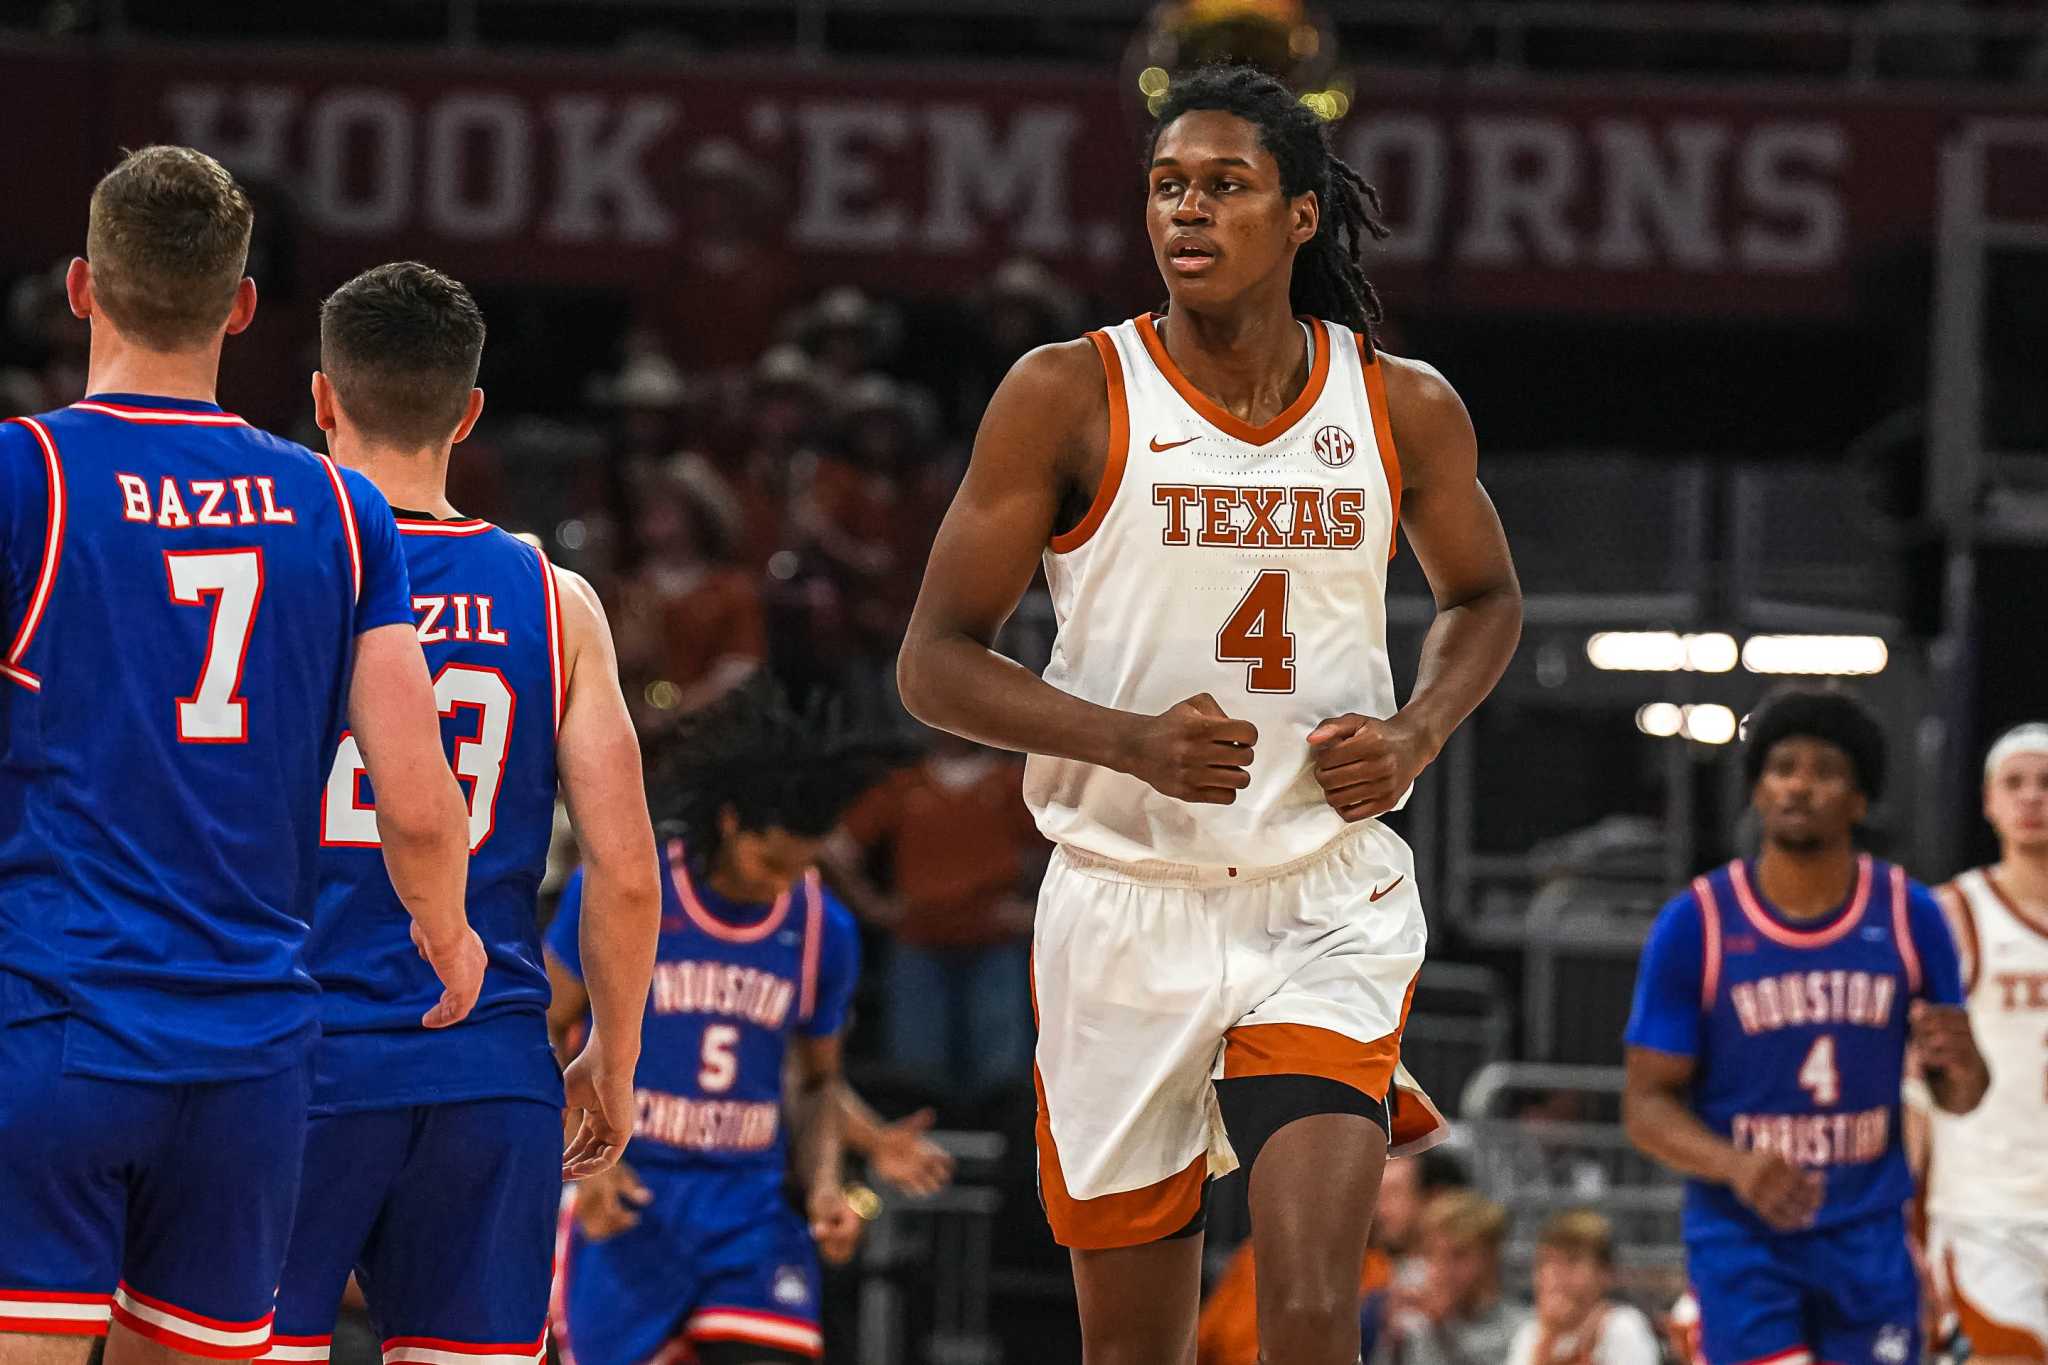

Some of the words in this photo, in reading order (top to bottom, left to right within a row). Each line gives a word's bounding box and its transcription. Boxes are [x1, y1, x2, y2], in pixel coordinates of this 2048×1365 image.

[1345, 112, 1850, 273] ORNS
[1314, 426, 1355, 466] SEC
[114, 472, 297, 528] BAZIL
[1152, 483, 1365, 550] TEXAS
[163, 546, 264, 743] 7
[411, 594, 509, 645] ZIL
[1215, 569, 1296, 695] 4
[1731, 970, 1896, 1035] HOUSTON
[696, 1022, 742, 1093] 5
[1798, 1032, 1841, 1106] 4
